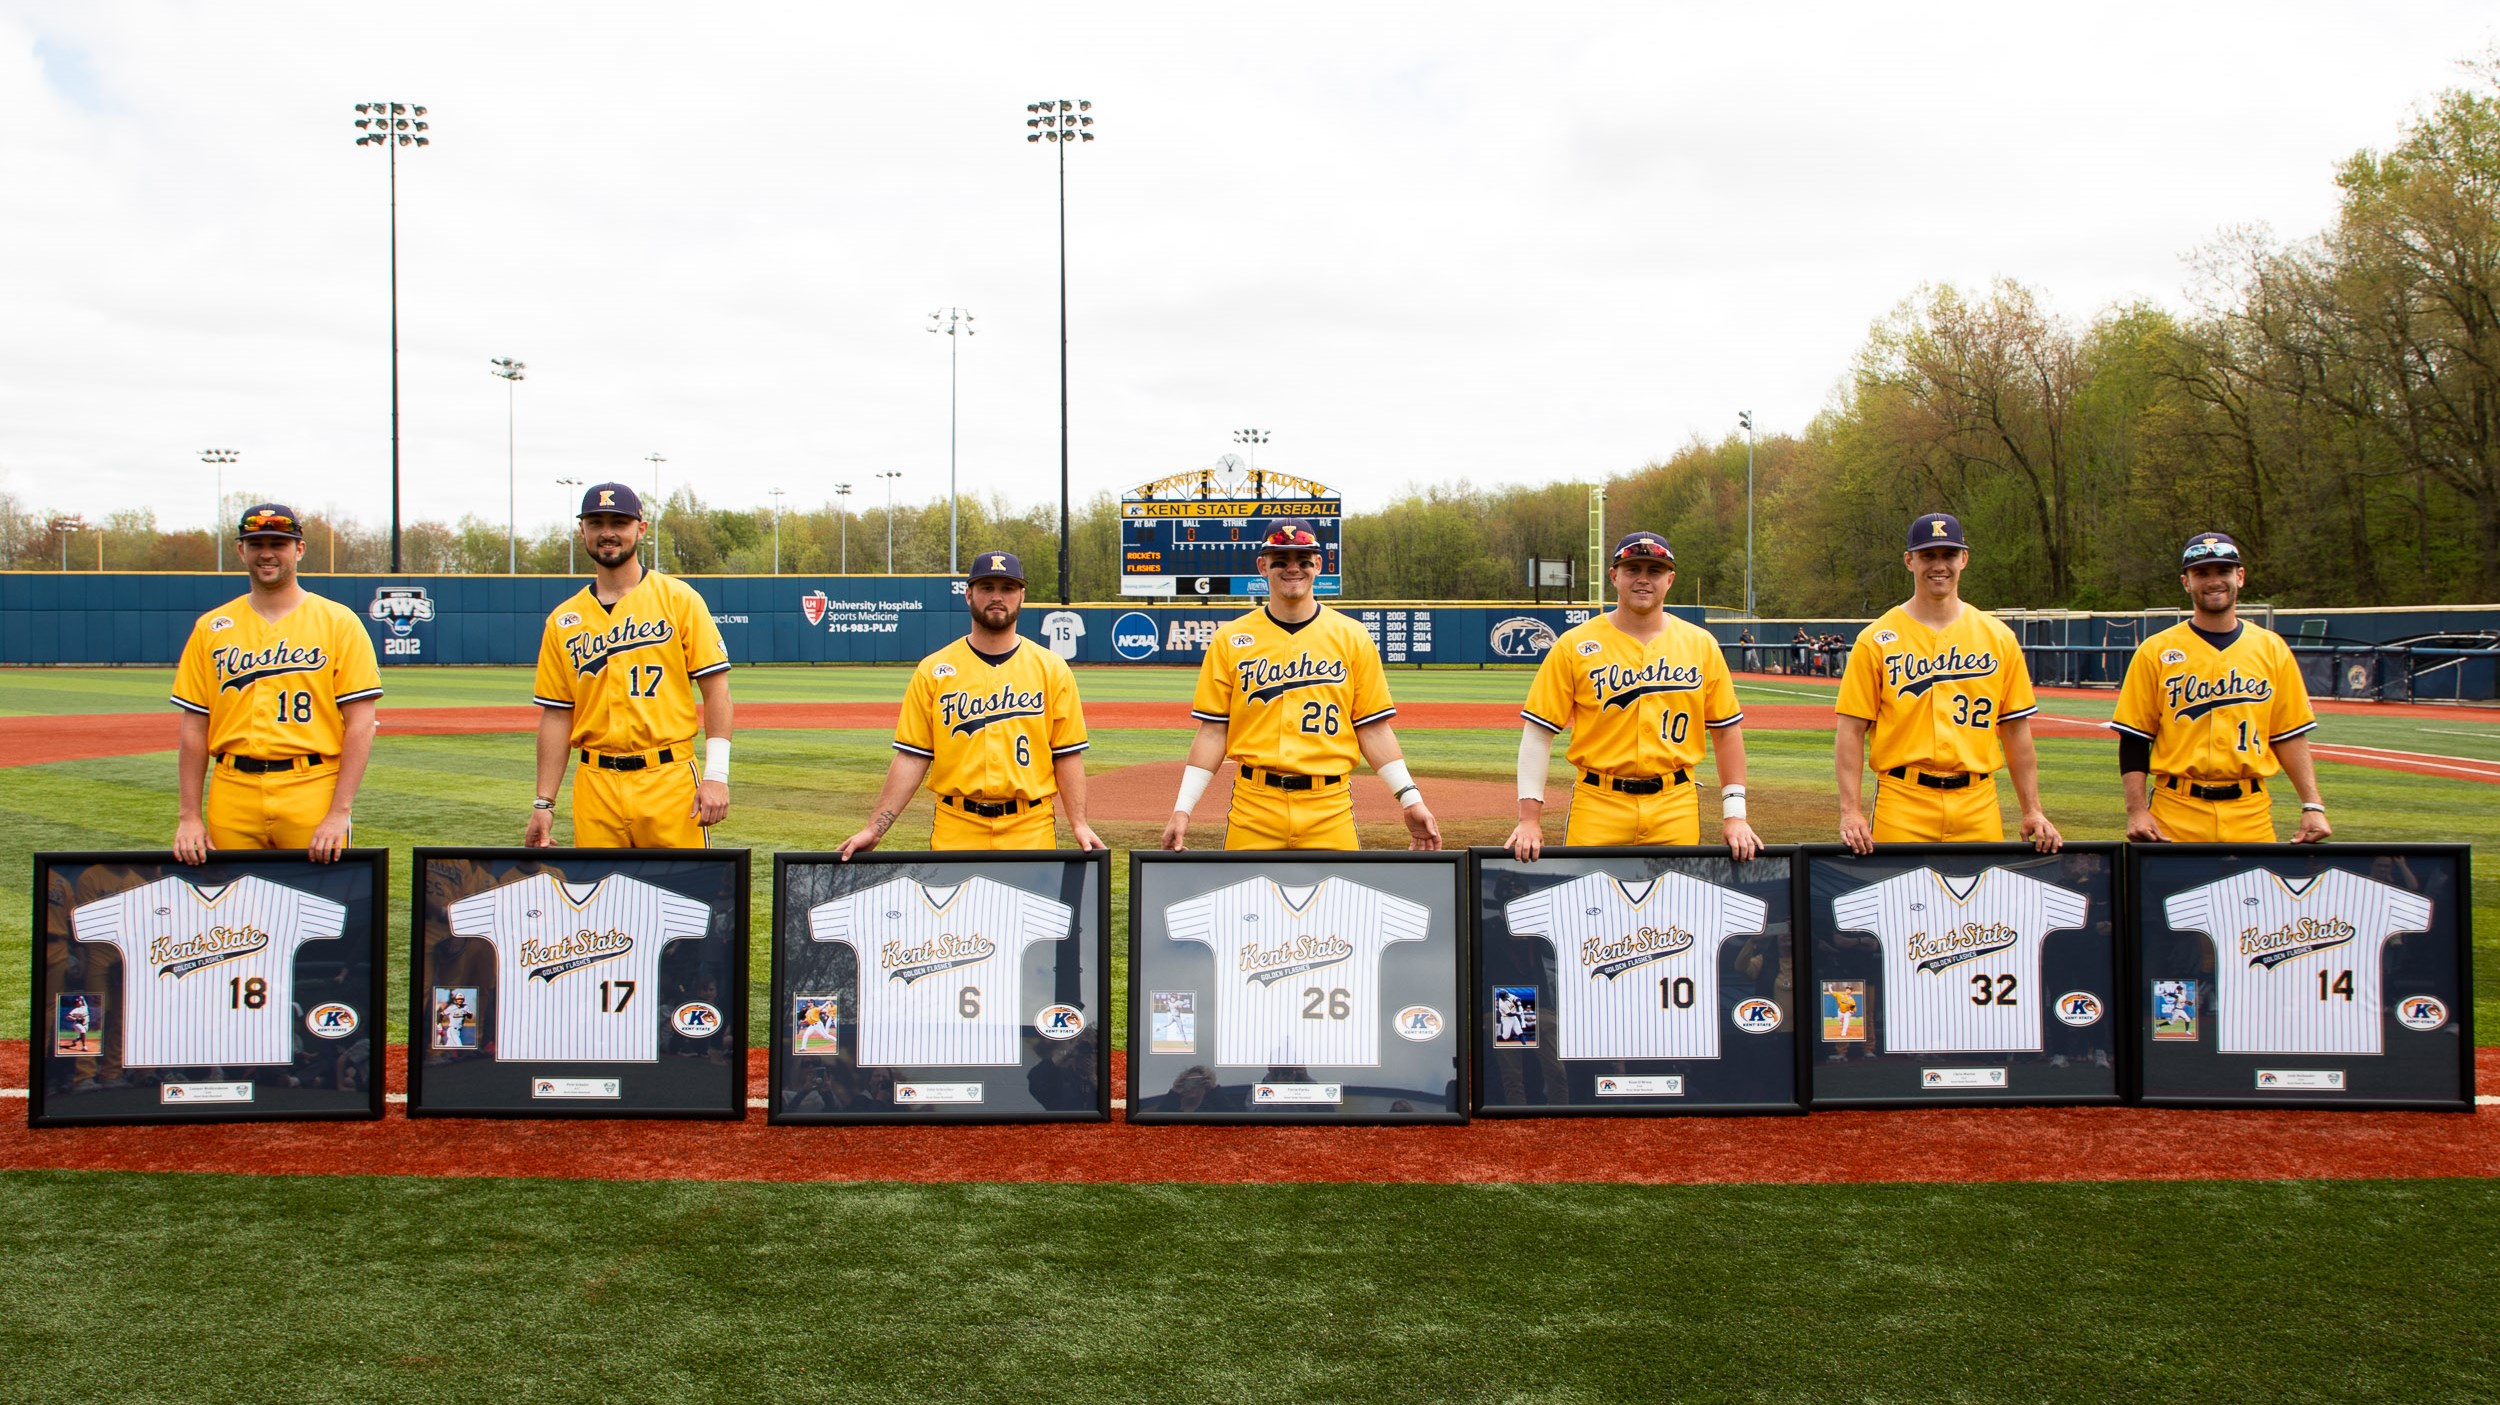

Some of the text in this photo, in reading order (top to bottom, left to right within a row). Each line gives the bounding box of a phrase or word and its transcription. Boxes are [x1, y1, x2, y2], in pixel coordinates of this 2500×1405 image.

[1136, 469, 1326, 499] SCHOONOVER STADIUM
[600, 490, 615, 506] K
[1147, 504, 1339, 515] KENT STATE BASEBALL
[1319, 519, 1332, 527] H/E
[1931, 521, 1947, 536] K
[1187, 528, 1195, 541] 0
[1231, 528, 1239, 541] 0
[991, 556, 1006, 571] K
[1127, 552, 1161, 560] ROCKETS
[1328, 550, 1335, 560] 0
[1328, 562, 1335, 573] 0
[951, 581, 968, 594] 35
[1194, 577, 1210, 594] G
[372, 598, 432, 619] CWS
[828, 600, 923, 612] University Hospitals
[828, 611, 899, 622] Sports Medicine
[1362, 611, 1430, 620] 1964 2002 2011
[1565, 610, 1589, 623] 320
[828, 623, 898, 633] 216-983-PLAY
[1056, 627, 1070, 640] 15
[1386, 622, 1407, 631] 2004
[1413, 622, 1431, 631] 2012
[565, 614, 674, 670] Flashes
[1117, 635, 1155, 647] NCAA
[1386, 632, 1407, 641] 2007
[1413, 632, 1431, 641] 2014
[385, 638, 421, 655] 2012
[1386, 642, 1407, 651] 2009
[212, 637, 328, 681] Flashes
[1388, 653, 1406, 661] 2010
[1237, 650, 1347, 693] Flashes
[1884, 645, 1998, 688] Flashes
[629, 664, 664, 698] 17
[1589, 656, 1703, 700] Flashes
[2164, 667, 2272, 709] Flashes
[276, 690, 312, 724] 18
[939, 683, 1045, 726] Flashes
[1951, 694, 1992, 729] 32
[1301, 701, 1340, 736] 26
[1661, 709, 1689, 745] 10
[1015, 734, 1030, 767] 6
[151, 923, 264, 964] Kent State
[1908, 920, 2012, 960] Kent State
[2240, 914, 2350, 956] Kent State
[520, 928, 627, 967] Kent State
[882, 932, 988, 968] Kent State
[1240, 934, 1345, 972] Kent State
[1583, 924, 1688, 966] Kent State
[173, 954, 225, 972] GOLDEN FLASHES
[1930, 950, 1977, 969] GOLDEN FLASHES
[2262, 945, 2313, 964] GOLDEN FLASHES
[542, 957, 591, 977] GOLDEN FLASHES
[903, 961, 953, 978] GOLDEN FLASHES
[1261, 964, 1311, 981] GOLDEN FLASHES
[1604, 955, 1653, 974] GOLDEN FLASHES
[230, 976, 268, 1010] 18
[1659, 977, 1694, 1009] 10
[1971, 974, 2017, 1006] 32
[2318, 969, 2354, 1001] 14
[600, 980, 636, 1013] 17
[959, 986, 980, 1018] 6
[1302, 987, 1351, 1020] 26
[1749, 1007, 1767, 1022] K
[2071, 1000, 2089, 1015] K
[2413, 1004, 2432, 1018] K
[324, 1011, 343, 1027] K
[688, 1011, 707, 1026] K
[1052, 1013, 1071, 1028] K
[1411, 1014, 1429, 1029] K
